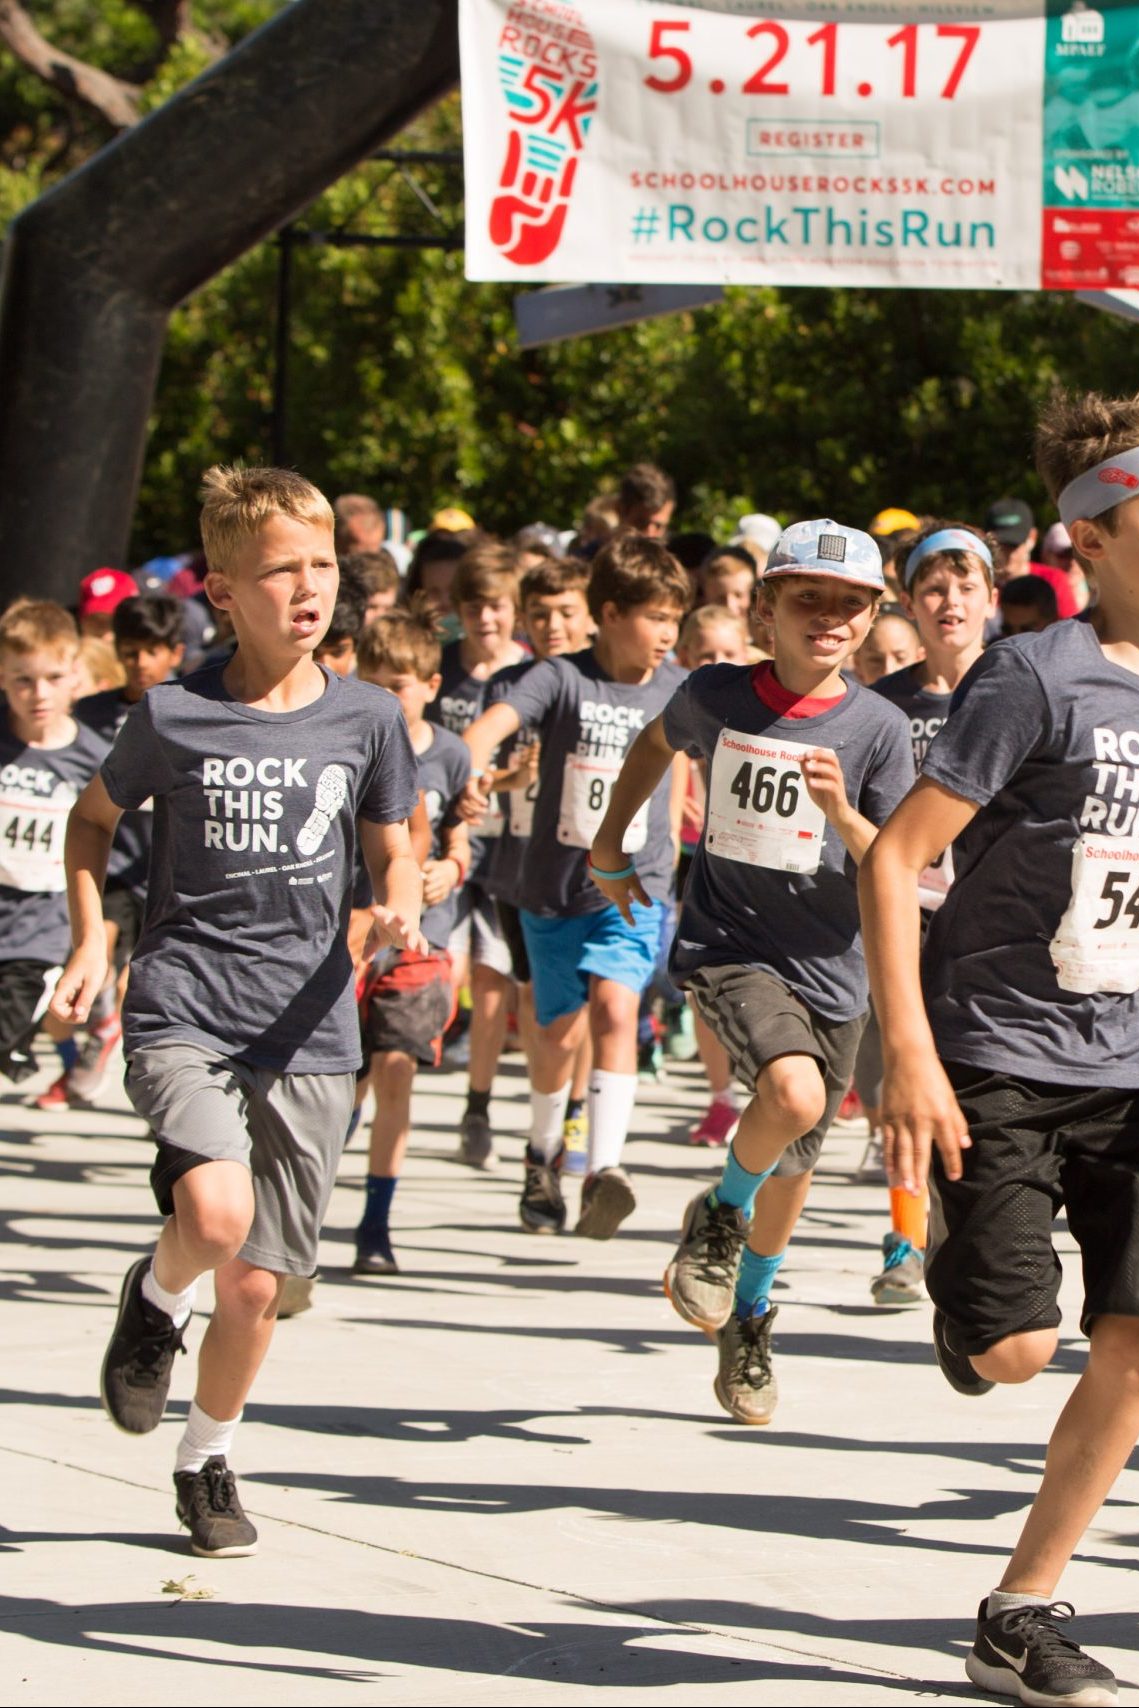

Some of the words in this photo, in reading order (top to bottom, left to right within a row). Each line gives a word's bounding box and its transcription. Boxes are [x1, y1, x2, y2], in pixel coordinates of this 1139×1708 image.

[499, 24, 598, 79] ROCKS
[643, 20, 981, 100] 5.21.17
[509, 65, 598, 151] 5K
[758, 131, 865, 149] REGISTER
[632, 204, 995, 248] #RockThisRun
[580, 701, 645, 729] ROCK
[580, 721, 629, 747] THIS
[722, 738, 777, 759] Schoolhouse
[0, 764, 55, 793] OCK
[203, 757, 308, 787] ROCK
[203, 789, 284, 821] THIS
[731, 761, 801, 818] 466
[5, 816, 53, 852] 444
[204, 819, 289, 853] RUN.
